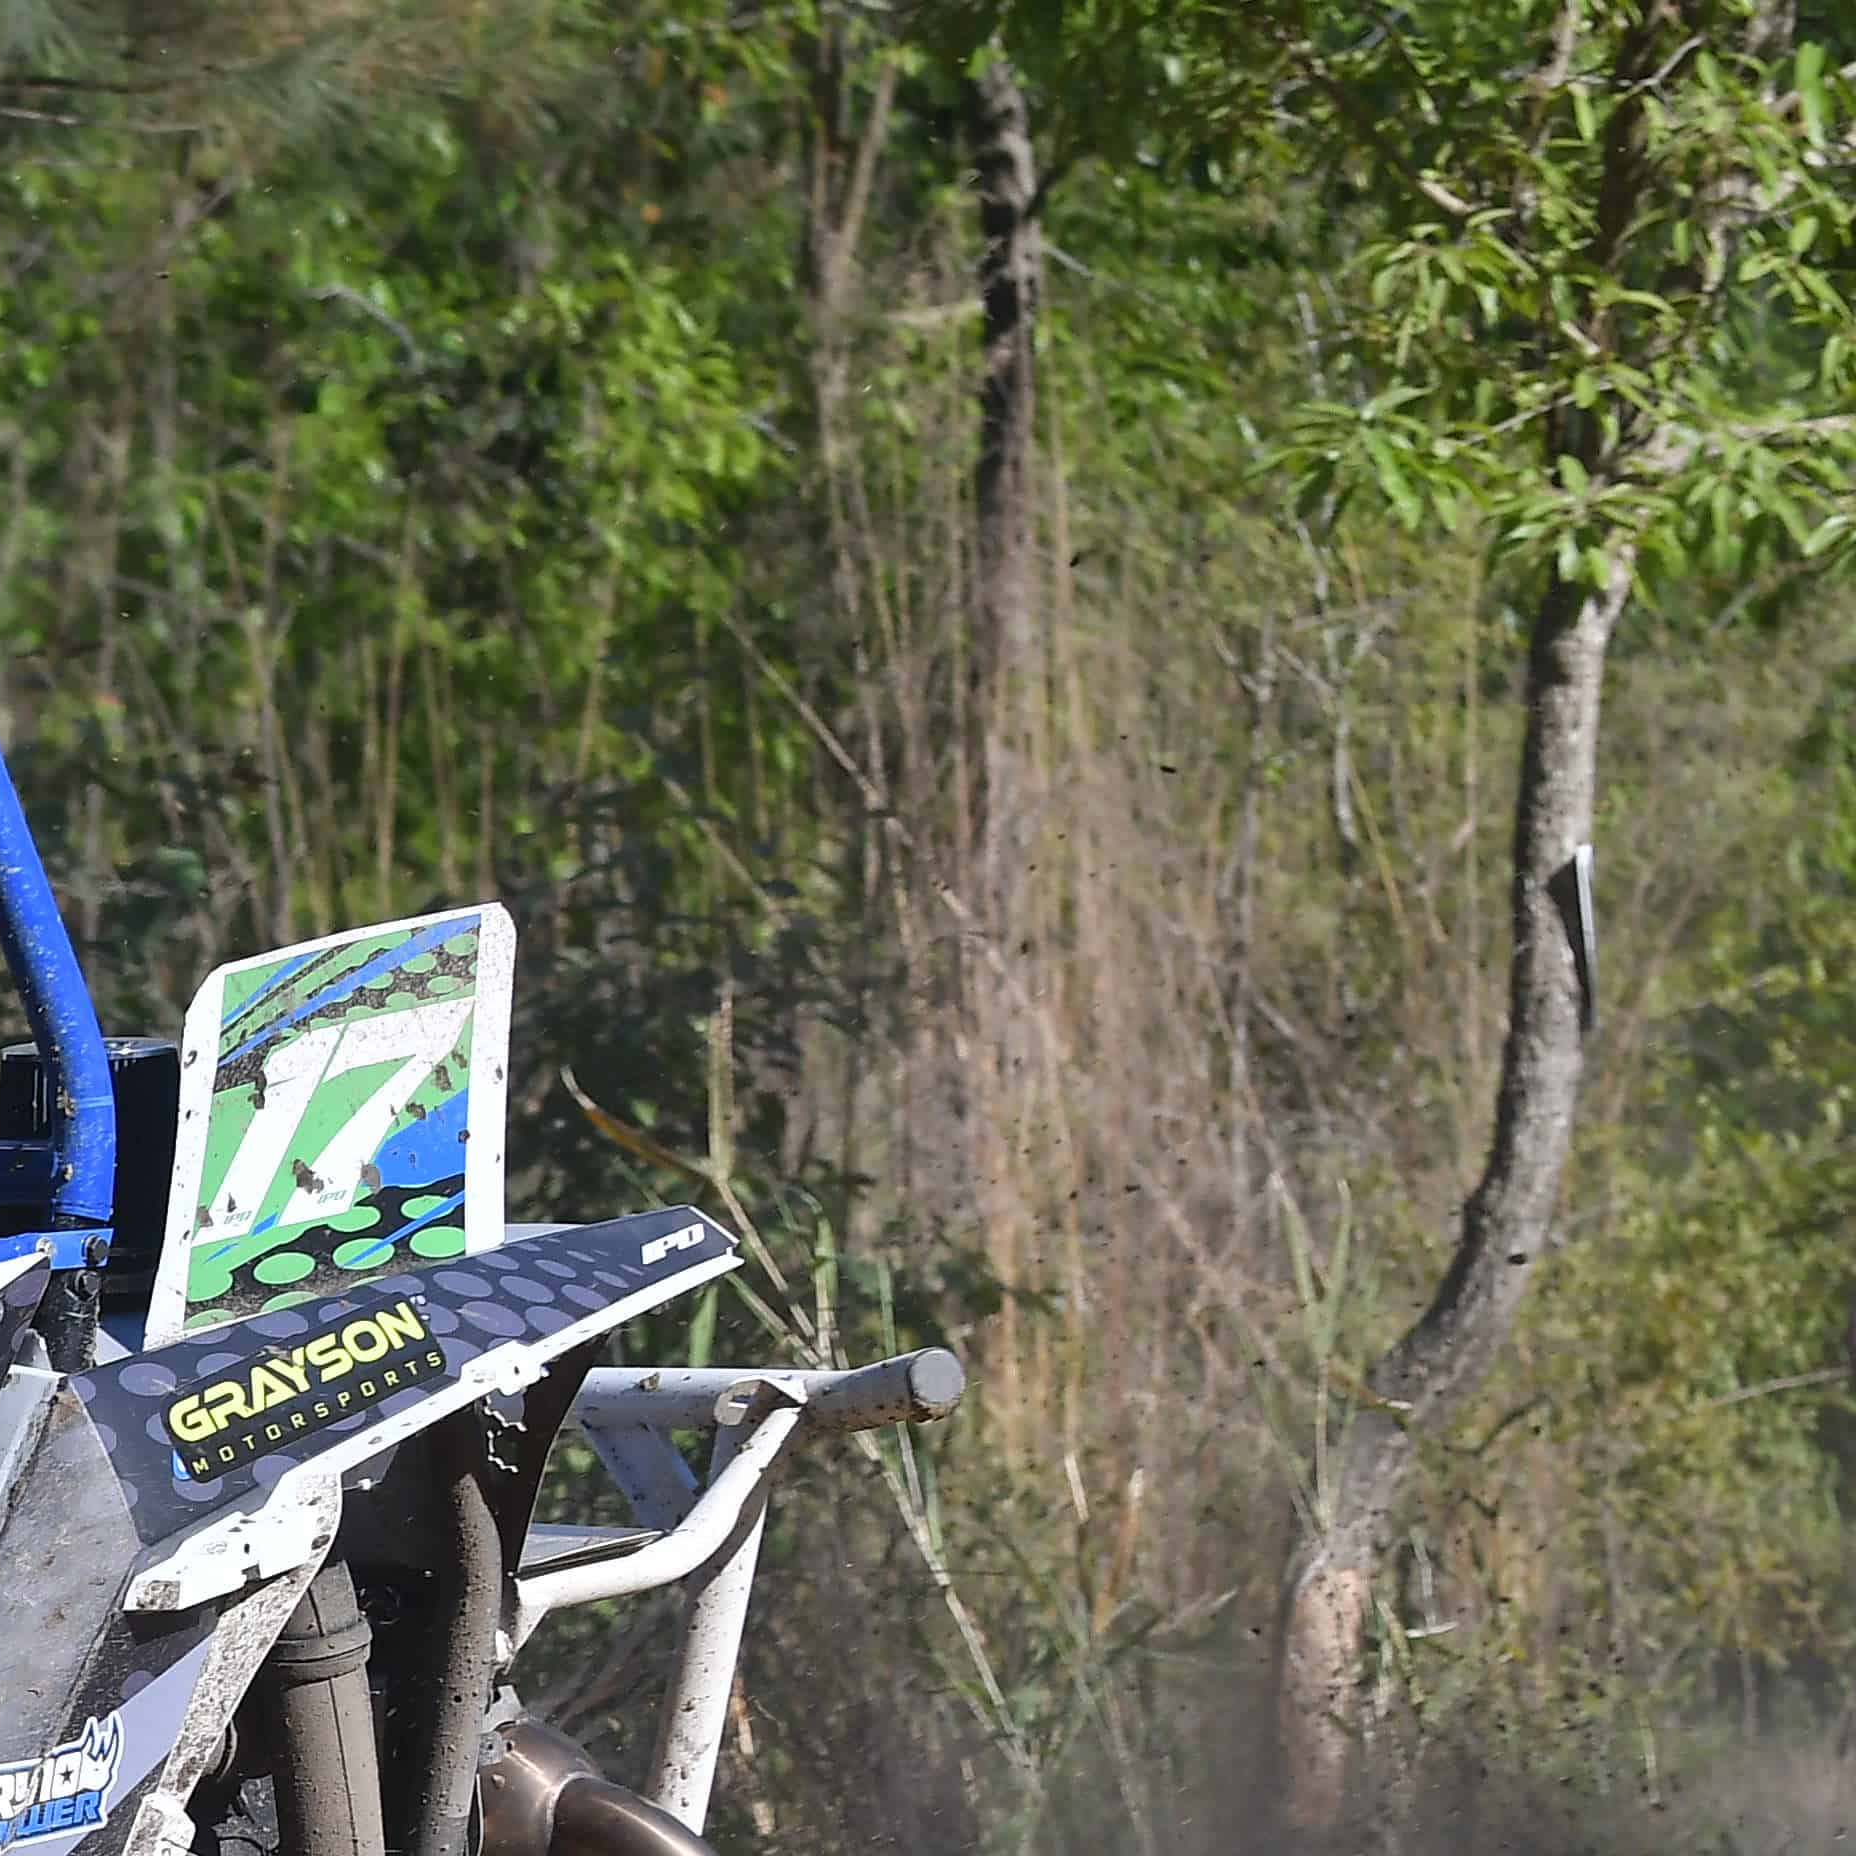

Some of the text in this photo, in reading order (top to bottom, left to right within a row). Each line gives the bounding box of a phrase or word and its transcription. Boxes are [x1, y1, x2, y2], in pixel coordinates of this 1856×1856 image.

[191, 998, 476, 1247] 17
[168, 1302, 426, 1443] GRAYSON
[191, 1351, 443, 1476] MOTORSPORTS
